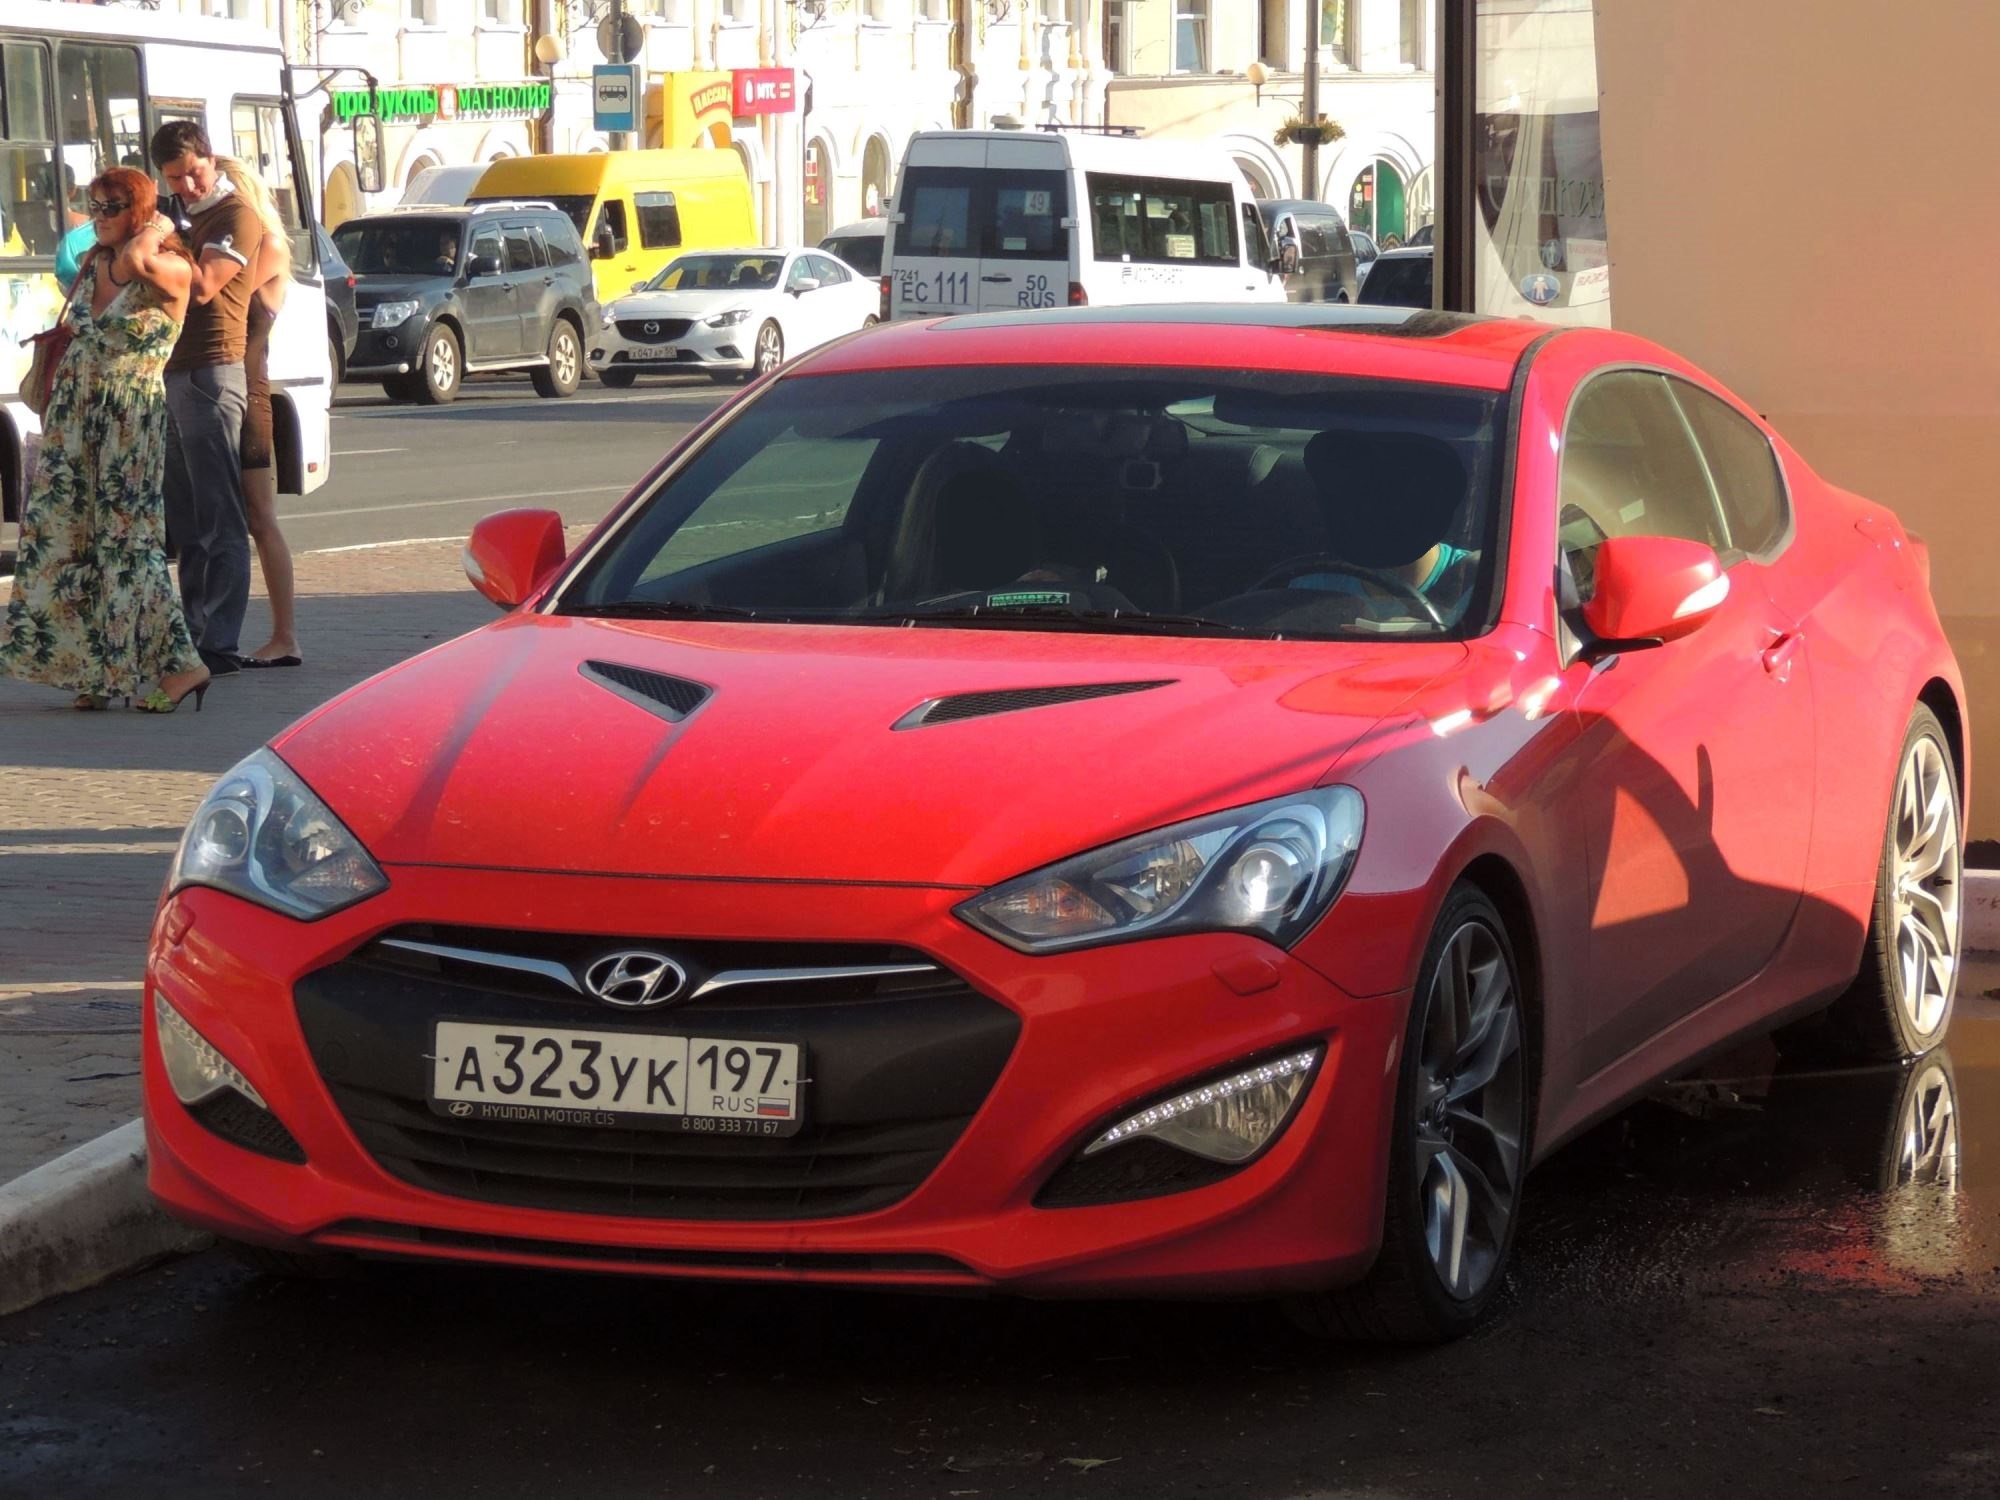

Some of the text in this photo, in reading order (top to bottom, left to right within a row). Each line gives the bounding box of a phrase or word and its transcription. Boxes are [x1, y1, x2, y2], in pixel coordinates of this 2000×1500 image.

[458, 85, 549, 111] МАГНОЛИЯ
[757, 82, 776, 99] МТС
[1030, 192, 1045, 211] 49
[893, 269, 919, 281] 7241
[1026, 275, 1047, 291] 50
[1018, 291, 1055, 308] RUS
[697, 1045, 782, 1094] 197
[712, 1096, 755, 1113] RUS
[482, 1105, 616, 1125] HYUNDAI MOTOR CIS
[682, 1117, 690, 1129] 8
[694, 1119, 716, 1131] 800
